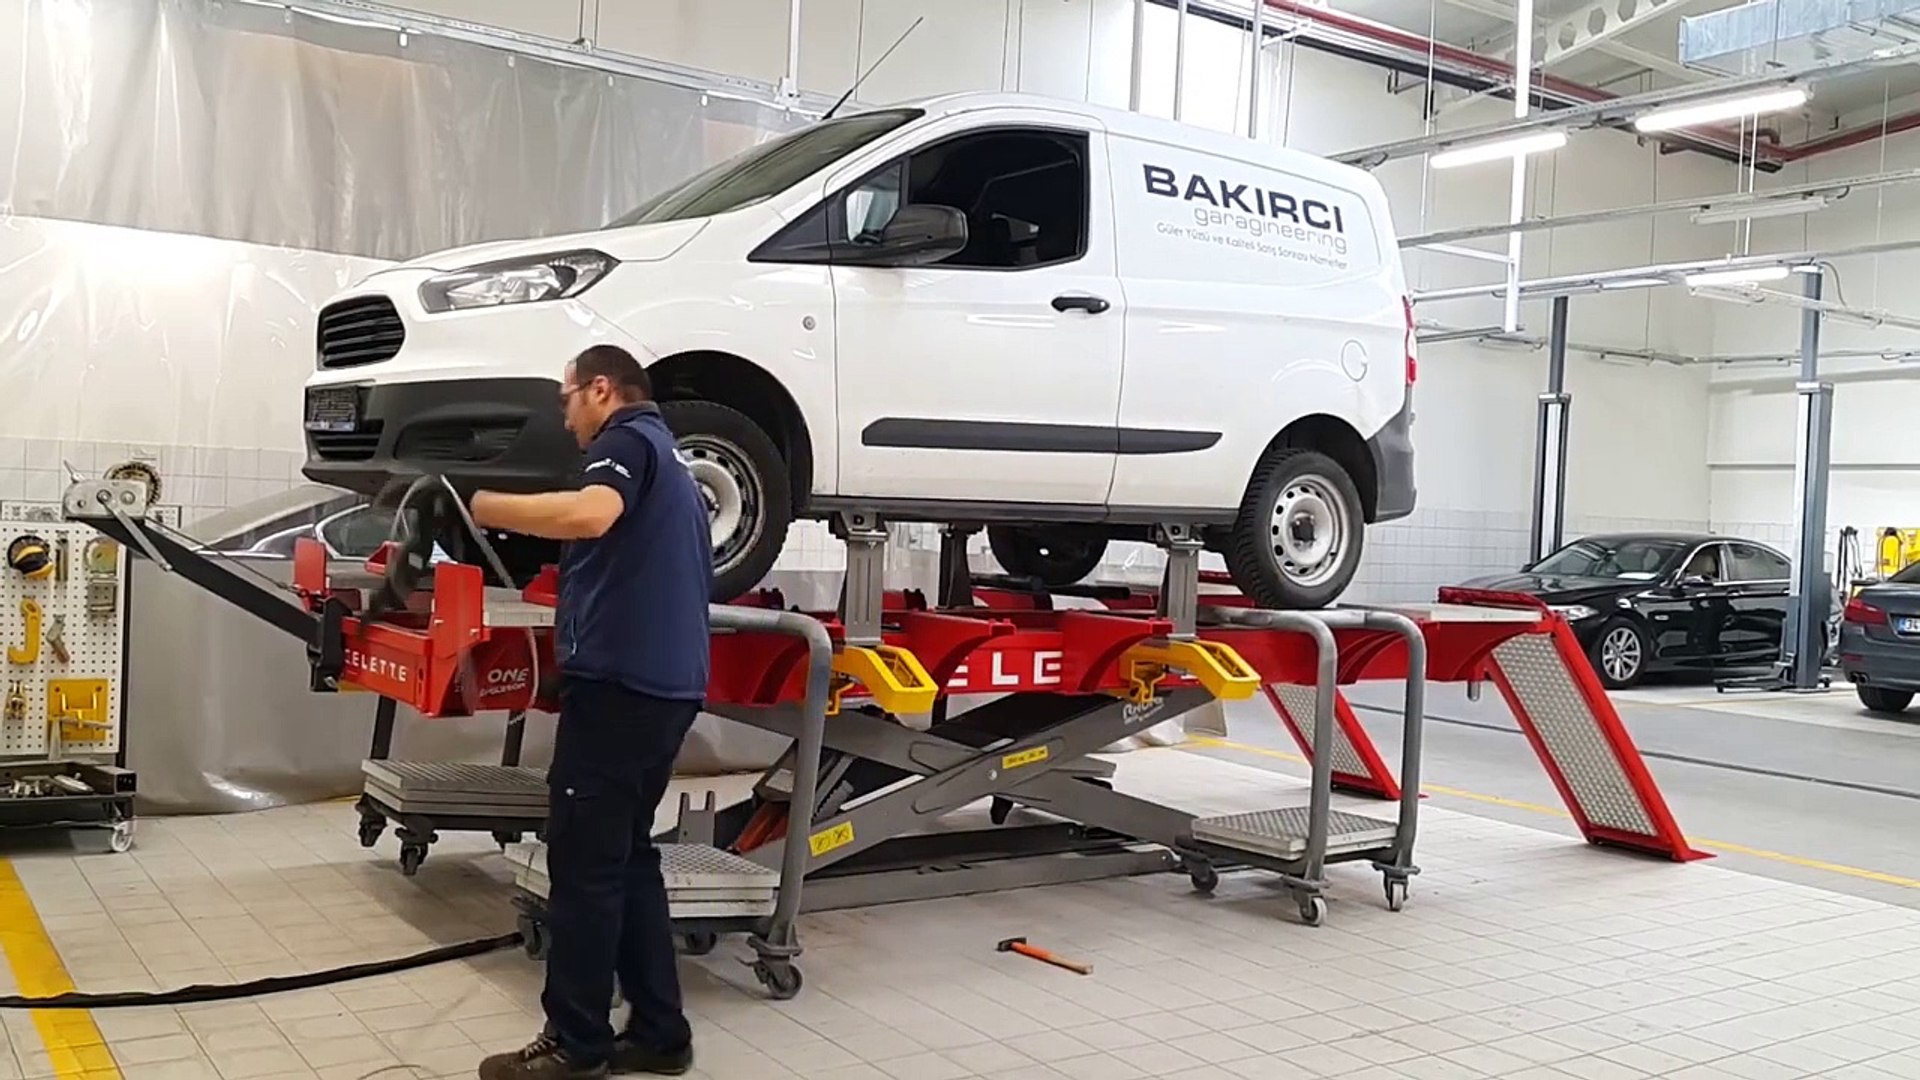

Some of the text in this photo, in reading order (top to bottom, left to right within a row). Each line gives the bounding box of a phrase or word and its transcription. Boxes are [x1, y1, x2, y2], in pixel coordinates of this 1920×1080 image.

[1143, 163, 1344, 233] BAKIRCI
[1194, 207, 1348, 255] garagineering
[487, 667, 530, 684] ONE
